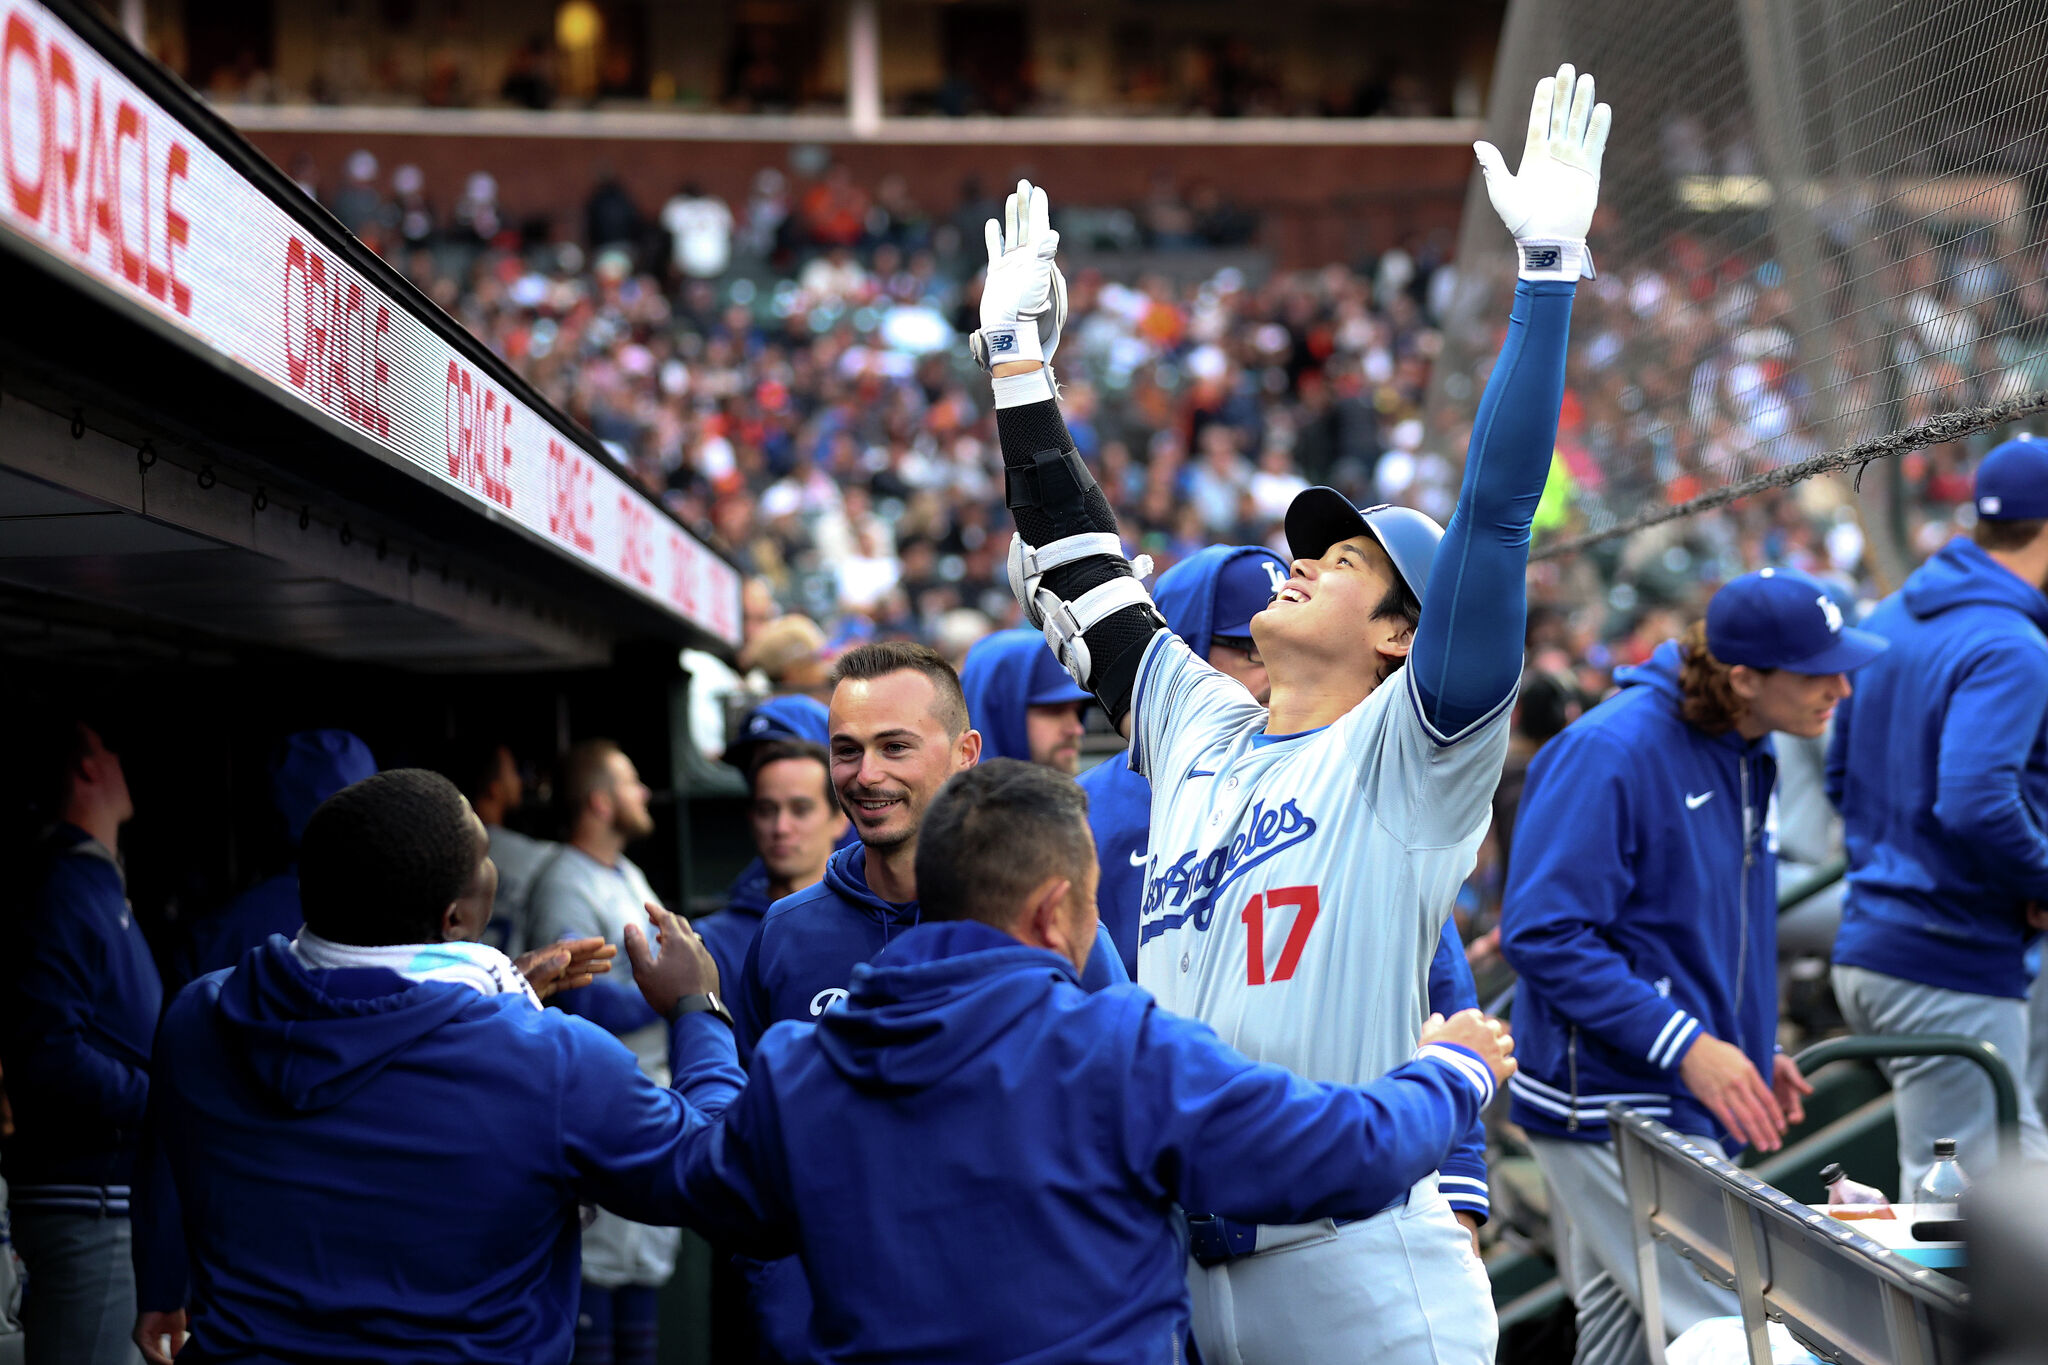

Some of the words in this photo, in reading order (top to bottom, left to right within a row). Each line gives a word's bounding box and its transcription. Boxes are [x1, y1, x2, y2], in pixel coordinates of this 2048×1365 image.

[3, 10, 191, 318] ORACLE
[284, 236, 390, 438] ORACLE
[446, 359, 512, 509] ORACLE
[1163, 797, 1317, 932] Angeles
[1241, 885, 1319, 986] 17
